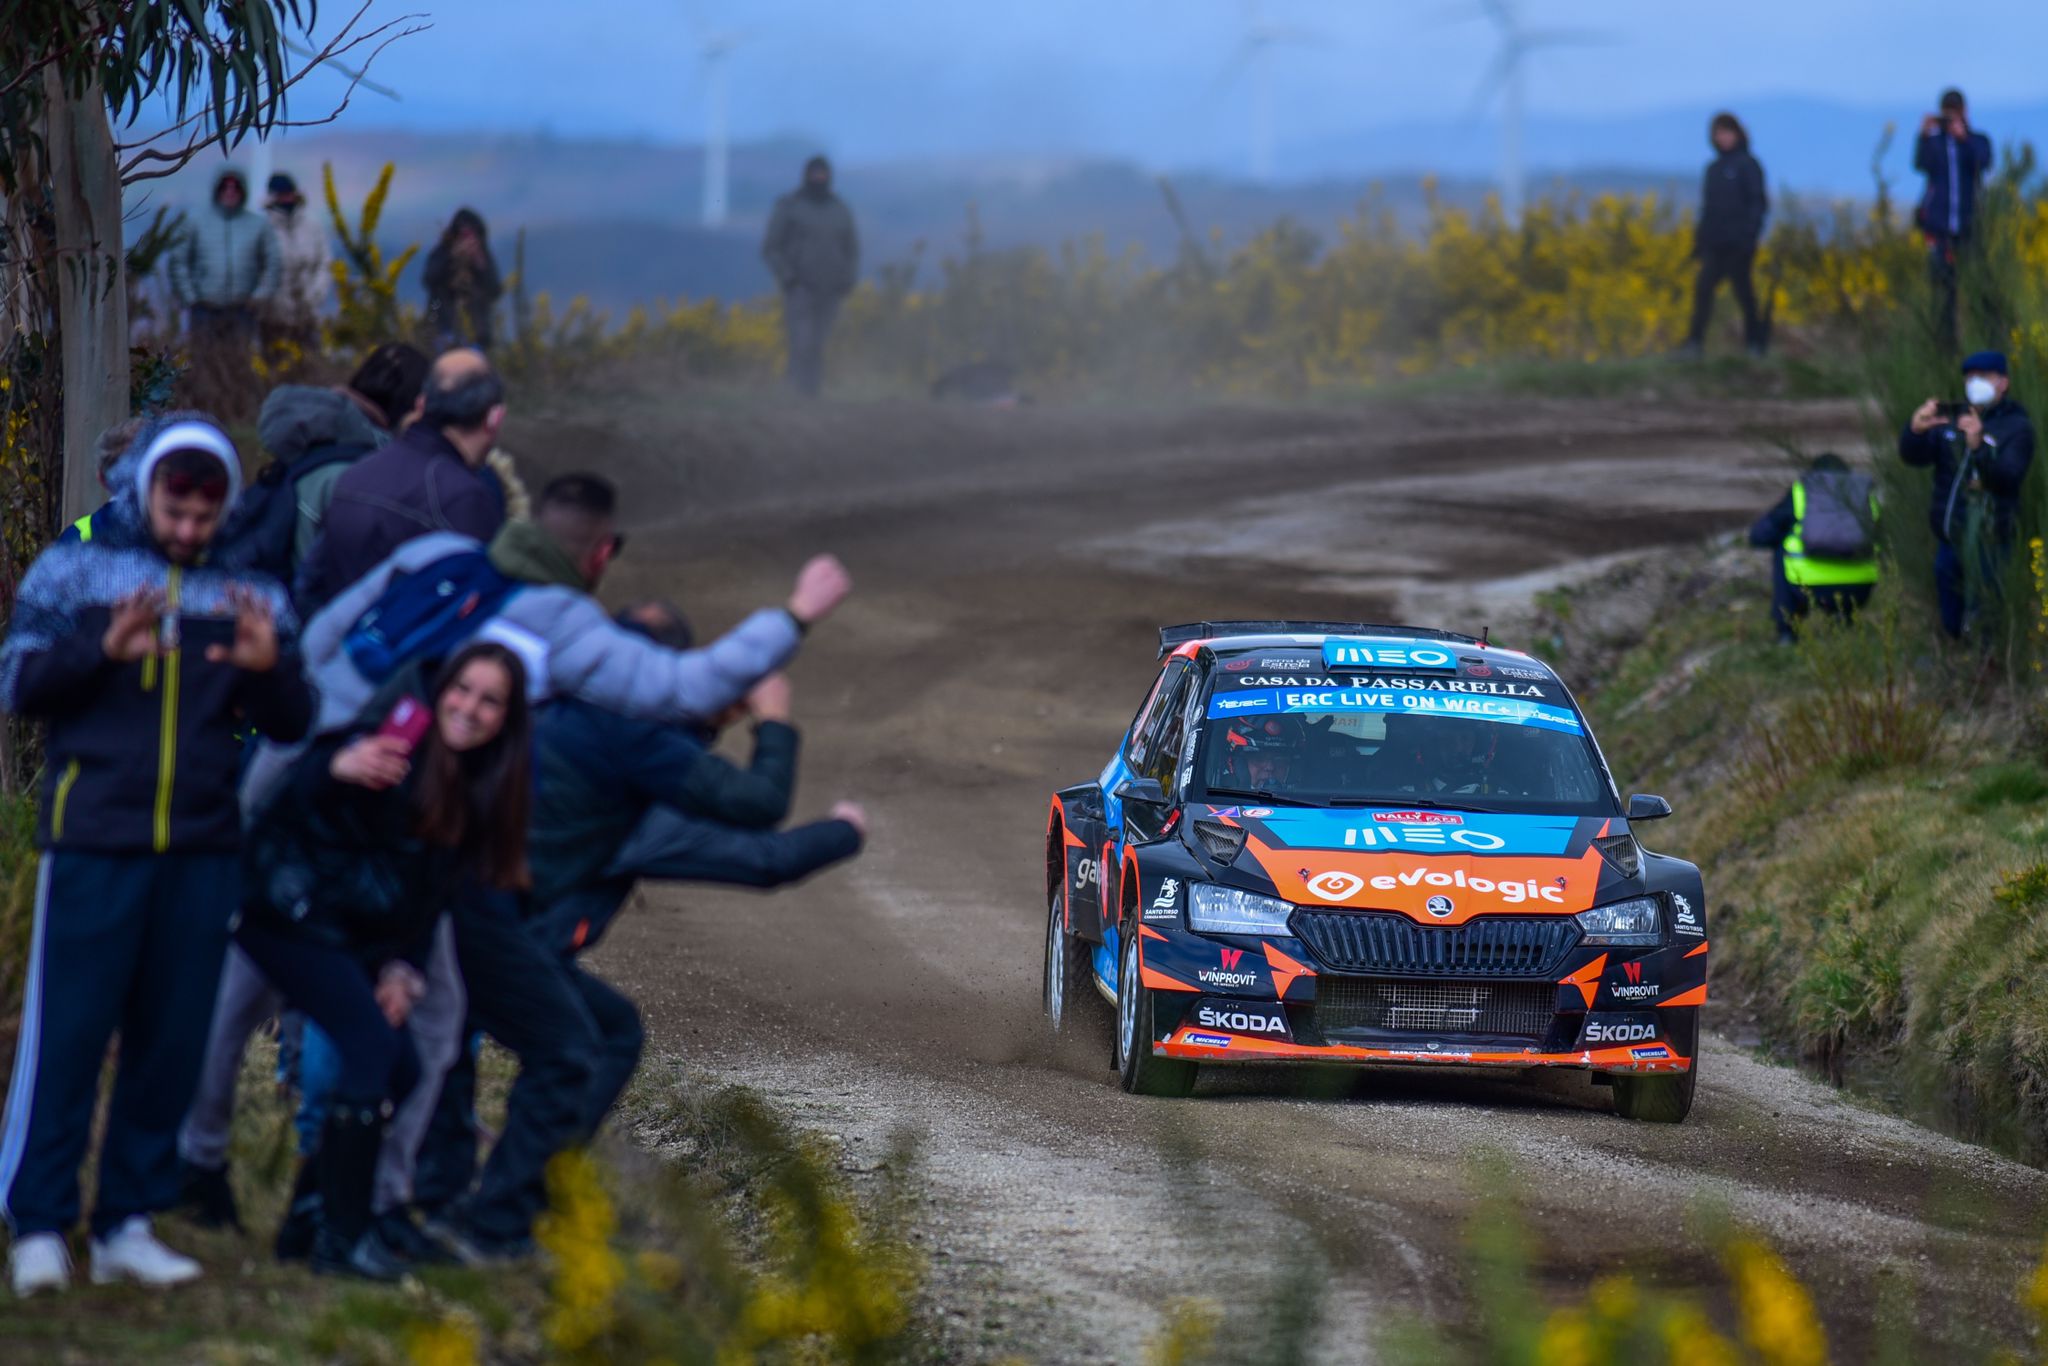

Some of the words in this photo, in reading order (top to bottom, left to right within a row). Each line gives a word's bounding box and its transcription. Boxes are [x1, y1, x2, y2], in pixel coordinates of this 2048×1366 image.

[1336, 648, 1448, 665] MEO
[1239, 676, 1301, 686] CASA
[1304, 677, 1338, 687] DA
[1350, 676, 1545, 698] PASSARELLA
[1286, 693, 1333, 706] ERC
[1340, 693, 1395, 707] LIVE
[1402, 695, 1436, 709] ON
[1374, 811, 1422, 820] RALLY
[1344, 826, 1506, 850] MEO
[1674, 923, 1690, 931] SANTO
[1198, 969, 1257, 986] WINPROVIT
[1611, 984, 1660, 997] WINPROVIT
[1199, 1007, 1286, 1033] ŠKODA
[1585, 1021, 1656, 1042] ŠKODA
[1194, 1036, 1229, 1045] MICHELIN
